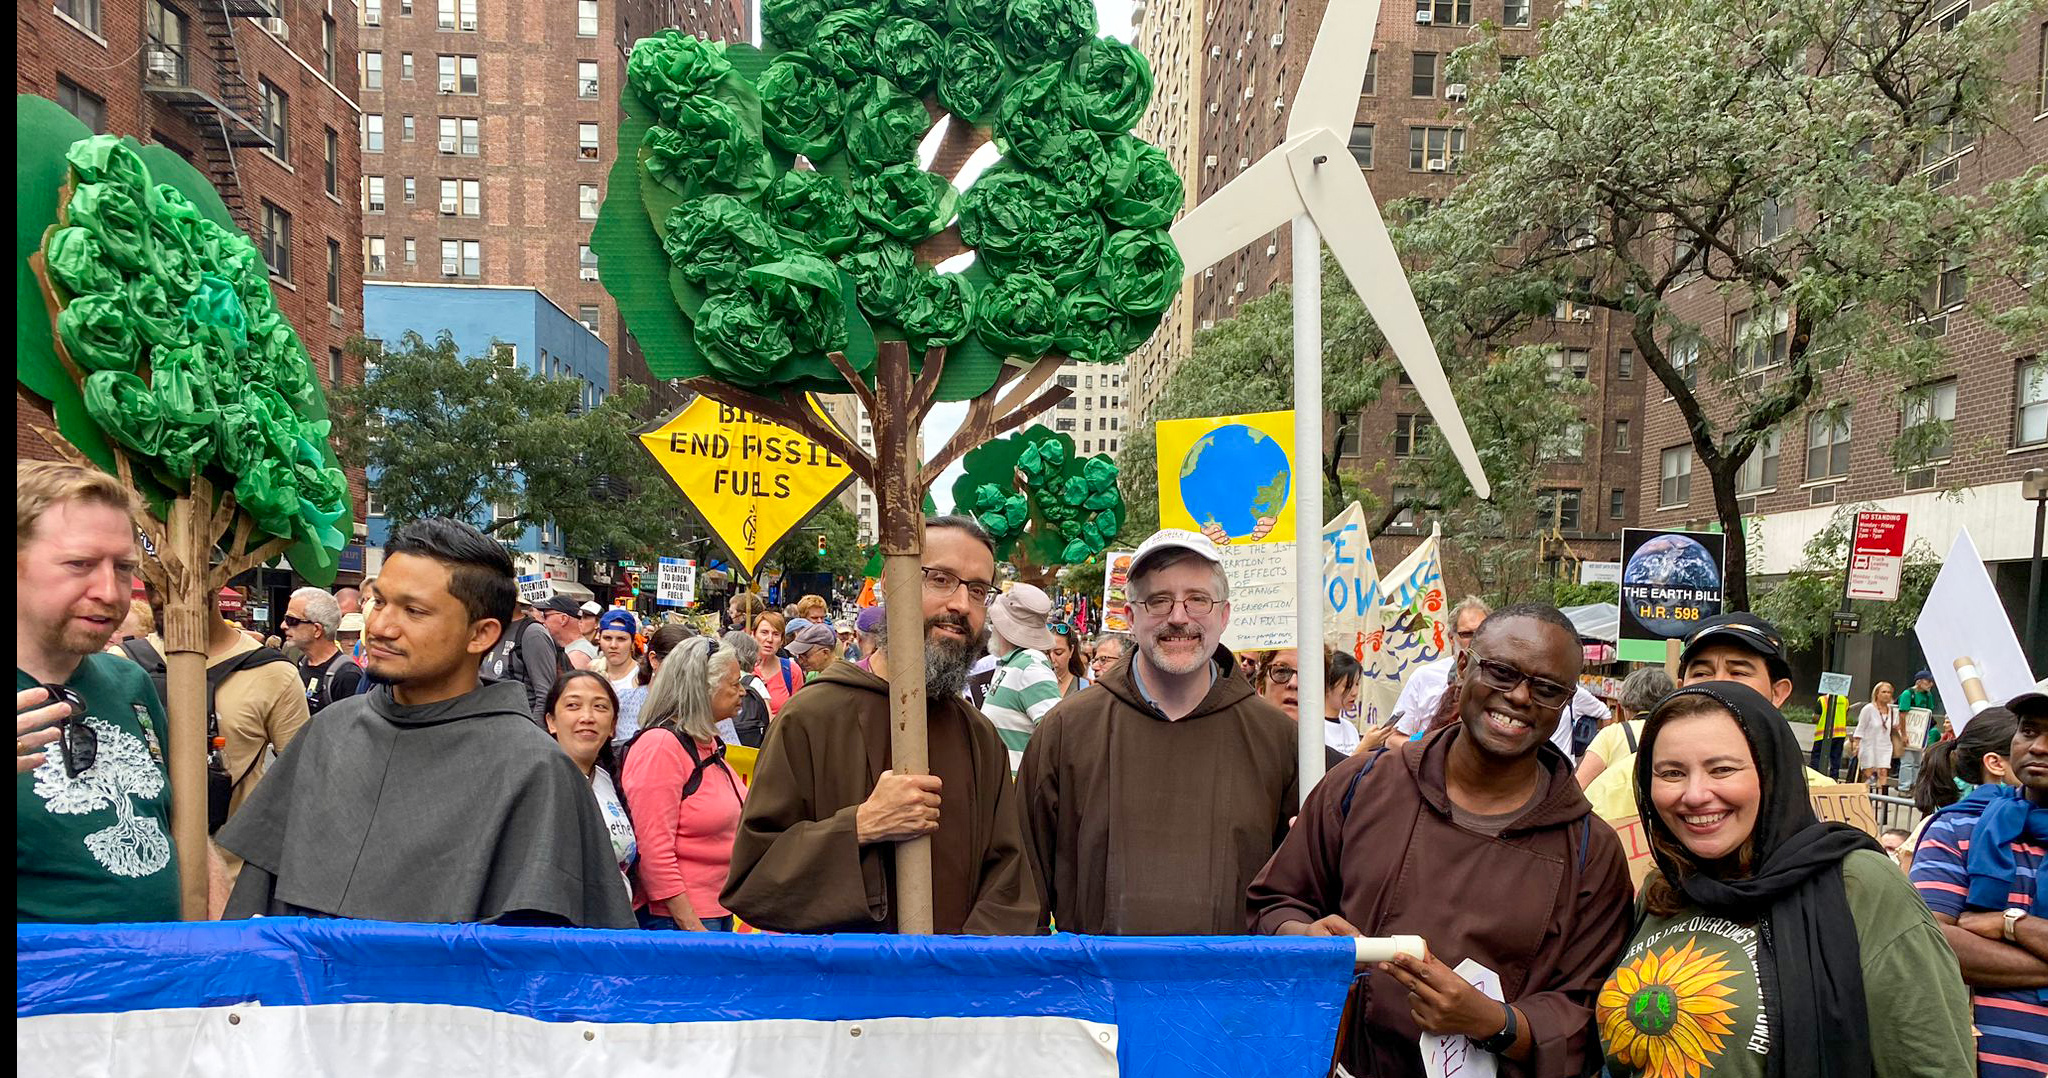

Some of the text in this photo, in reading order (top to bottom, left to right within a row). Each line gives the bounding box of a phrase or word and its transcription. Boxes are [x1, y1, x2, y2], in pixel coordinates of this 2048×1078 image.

[670, 432, 729, 459] END
[1860, 513, 1901, 522] NO STANDING
[1248, 544, 1266, 554] THE
[1222, 556, 1282, 569] ERATION TO
[662, 564, 692, 575] SCIENTISTS
[1243, 566, 1288, 579] EFFECTS
[664, 572, 671, 581] TO
[520, 580, 549, 593] SCIENTISTS
[661, 581, 672, 590] END
[672, 582, 691, 592] FOSSIL
[1240, 585, 1280, 598] CHANGE
[667, 590, 684, 600] FUELS
[1323, 575, 1377, 617] OW
[1623, 586, 1721, 602] THE EARTH BILL
[1640, 605, 1699, 620] H.R. 598
[1233, 615, 1257, 626] CAN
[1260, 615, 1276, 626] FIX
[1813, 795, 1879, 838] ELESS
[1646, 931, 1662, 948] OF
